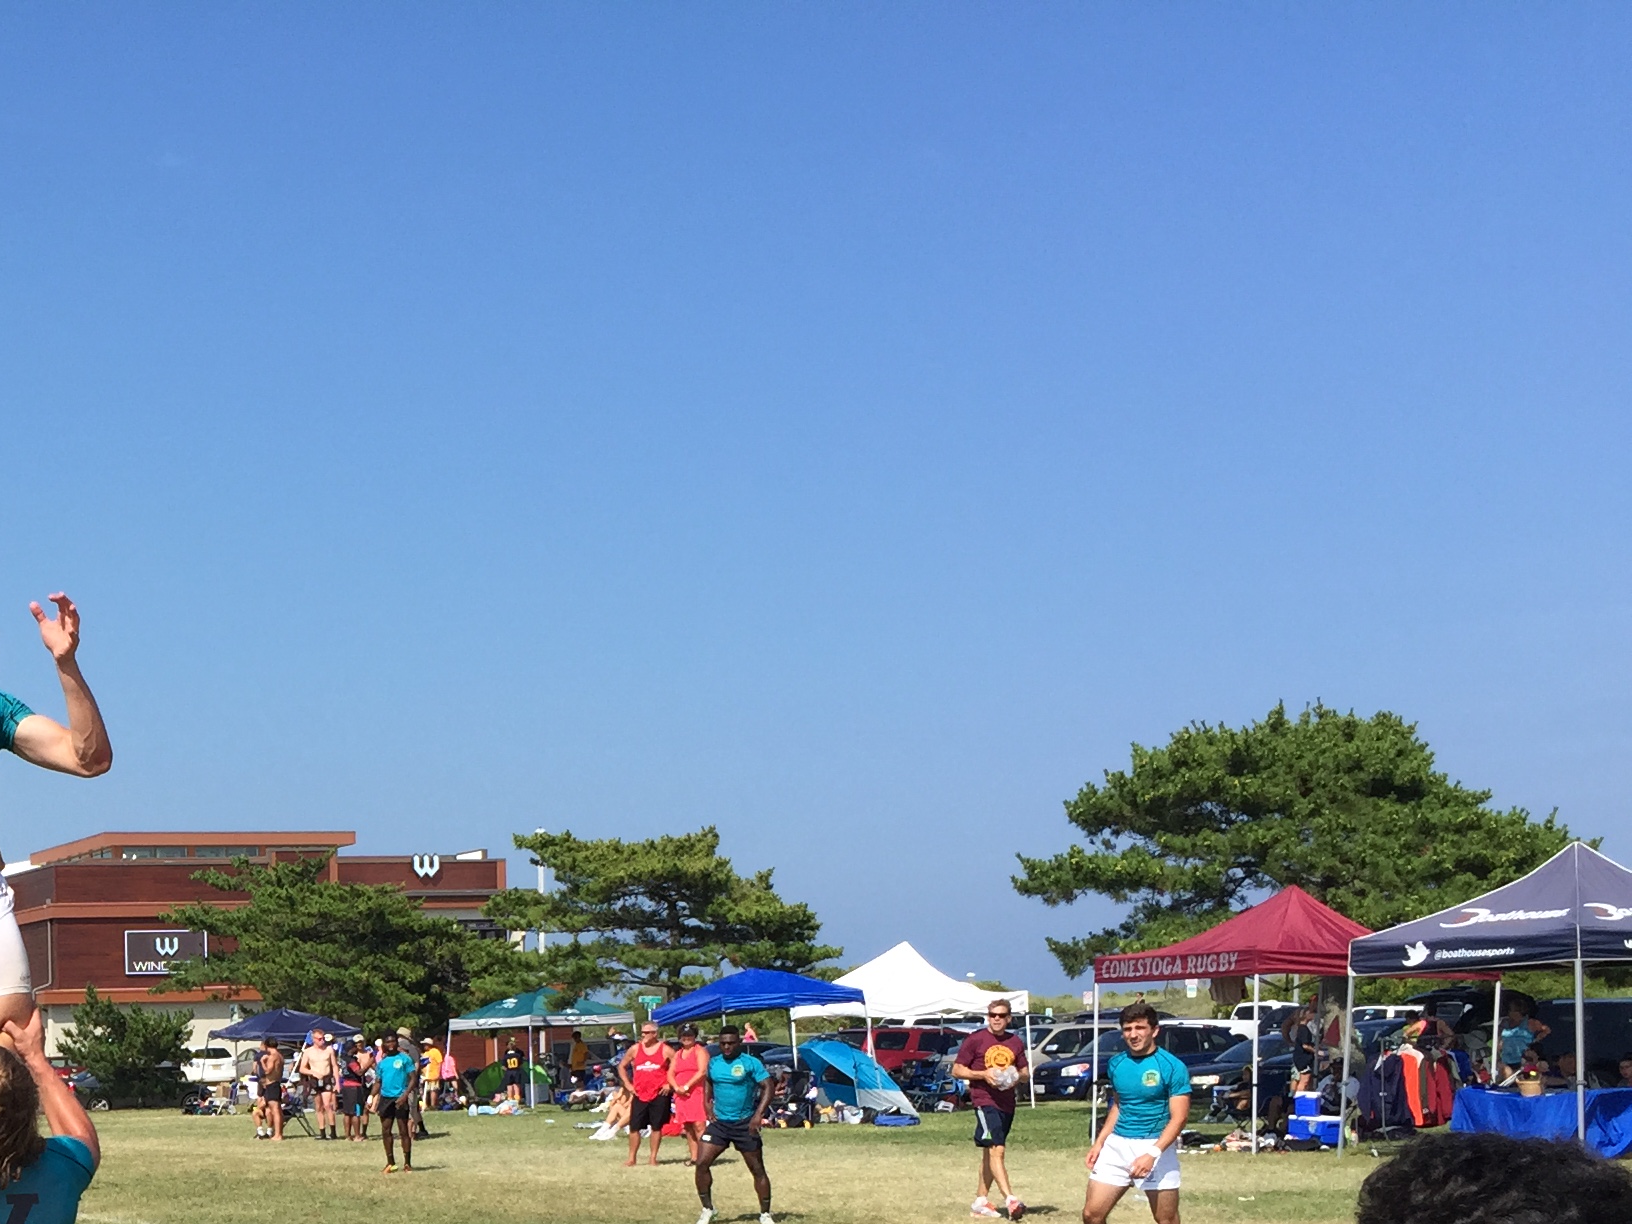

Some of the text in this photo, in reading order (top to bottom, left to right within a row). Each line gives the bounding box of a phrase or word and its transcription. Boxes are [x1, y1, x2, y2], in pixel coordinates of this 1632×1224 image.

[413, 854, 440, 878] W
[155, 936, 179, 956] W
[1434, 946, 1516, 961] @boathousesports
[1101, 951, 1239, 979] CONESTOGA RUGBY
[507, 1057, 518, 1069] 10
